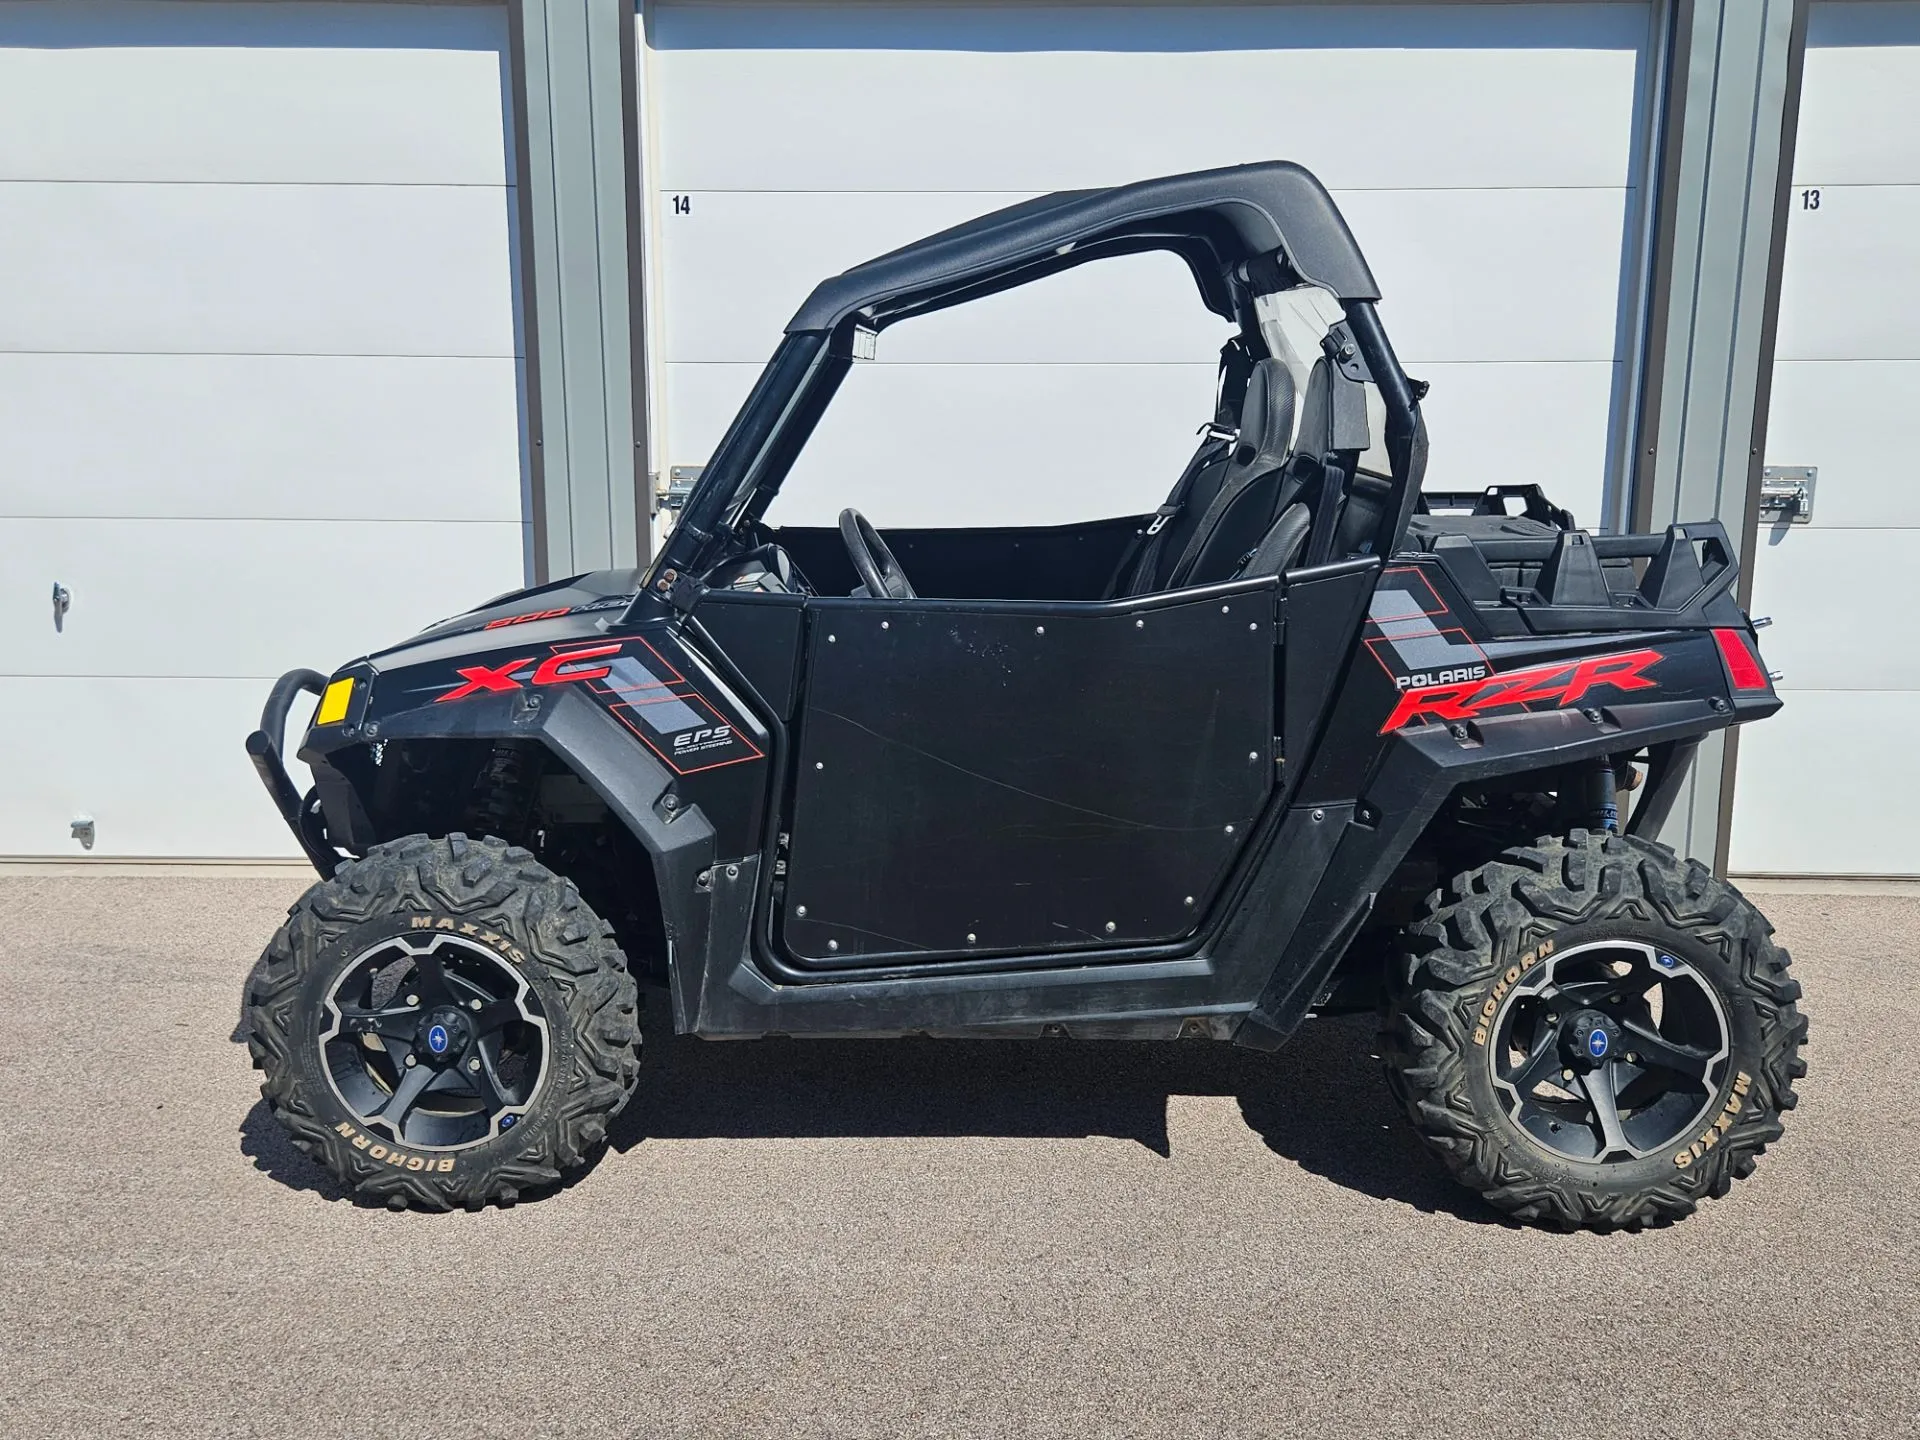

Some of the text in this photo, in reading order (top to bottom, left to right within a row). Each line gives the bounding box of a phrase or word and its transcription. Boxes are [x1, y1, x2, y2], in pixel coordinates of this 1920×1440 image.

[672, 195, 690, 215] 14
[1802, 190, 1820, 210] 13
[434, 643, 623, 702] XC
[1377, 648, 1665, 736] RZR
[1396, 665, 1486, 689] POLARIS
[674, 725, 731, 747] EPS
[411, 915, 525, 963] MAXXIS
[1472, 940, 1554, 1046] BIGHORN
[1673, 1071, 1752, 1169] MAXXIS
[335, 1122, 456, 1172] BIGHORN
